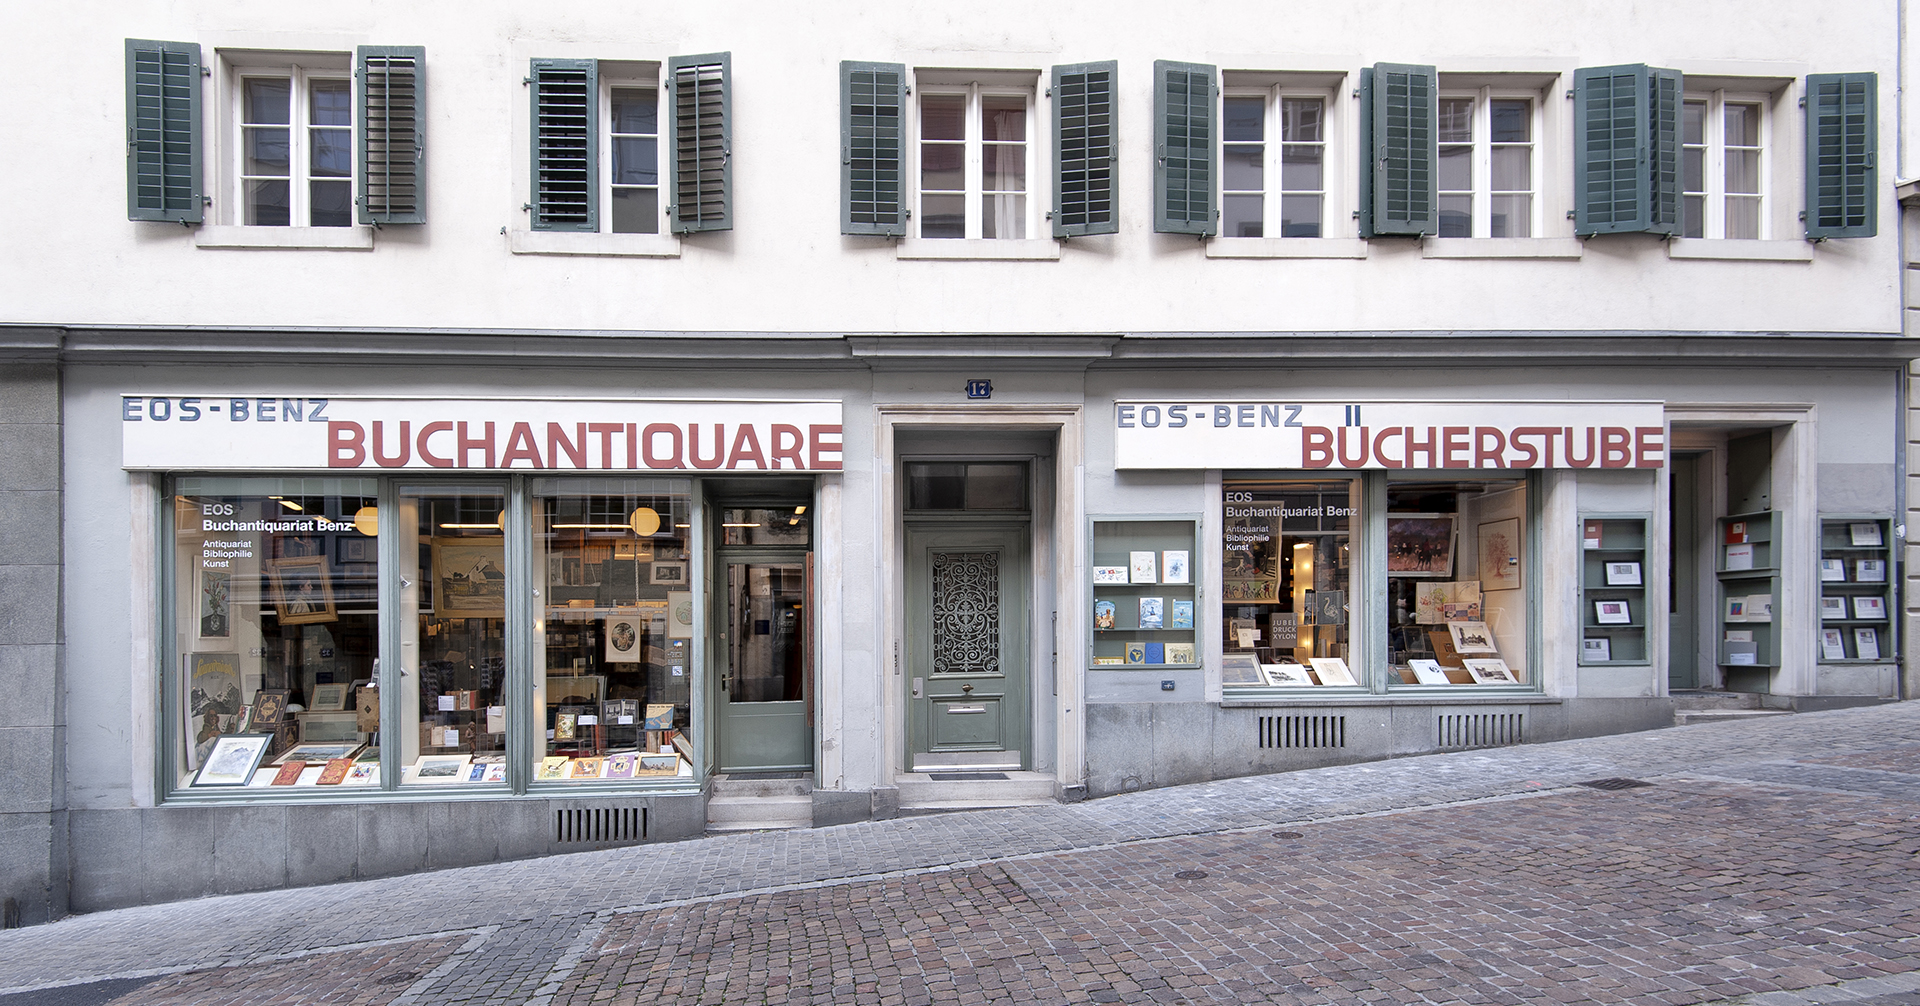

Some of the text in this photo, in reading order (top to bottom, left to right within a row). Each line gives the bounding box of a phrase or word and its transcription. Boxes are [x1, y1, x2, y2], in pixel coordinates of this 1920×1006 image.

[971, 383, 987, 395] 17
[123, 398, 329, 422] EOS-BENZ
[1118, 405, 1303, 428] EOS-BENZ
[1302, 405, 1664, 468] BÜCHERSTUBE
[328, 421, 843, 469] BUCHANTIQUARE
[1226, 492, 1253, 502] EOS
[203, 504, 233, 515] EOS
[1226, 506, 1358, 518] Buchantiquariat Benz
[203, 520, 352, 533] Buchantiquariat Benz
[1226, 525, 1269, 534] Antiquariat
[1226, 534, 1270, 542] Bibliophilie
[203, 540, 252, 549] Antiquariat
[1226, 543, 1249, 551] Kunst
[203, 550, 253, 559] Bibliophilie
[203, 560, 229, 568] Kunst
